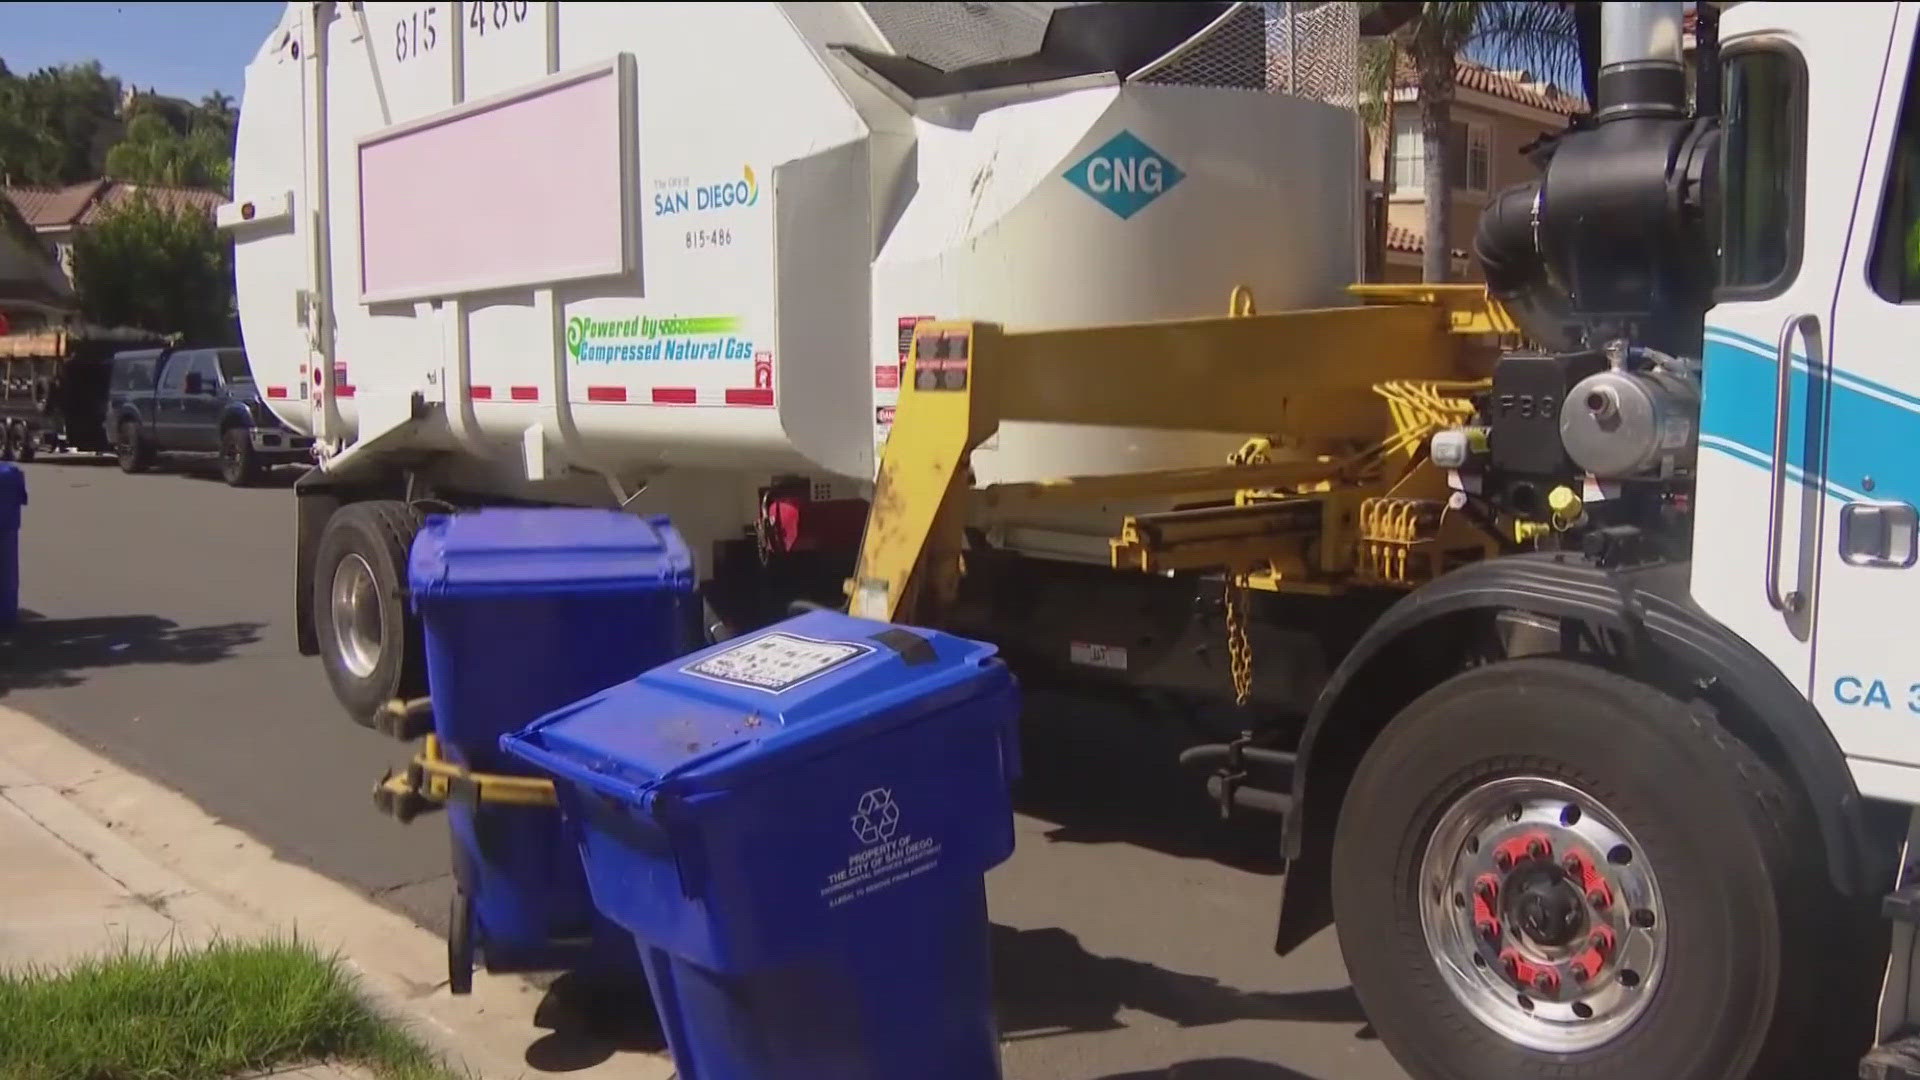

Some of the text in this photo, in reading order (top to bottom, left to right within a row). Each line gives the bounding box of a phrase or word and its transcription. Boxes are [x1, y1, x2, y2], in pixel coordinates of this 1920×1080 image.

[395, 7, 437, 63] 815
[1087, 157, 1163, 193] CNG
[654, 180, 748, 216] SAN DIEGO
[685, 228, 732, 249] 815-486
[583, 315, 659, 340] Powered by
[580, 337, 753, 364] Compressed Natural Gas
[1833, 676, 1891, 710] CA
[828, 837, 934, 884] THE CITY OF SAN DIEGO
[848, 835, 912, 867] PROPERTY OF
